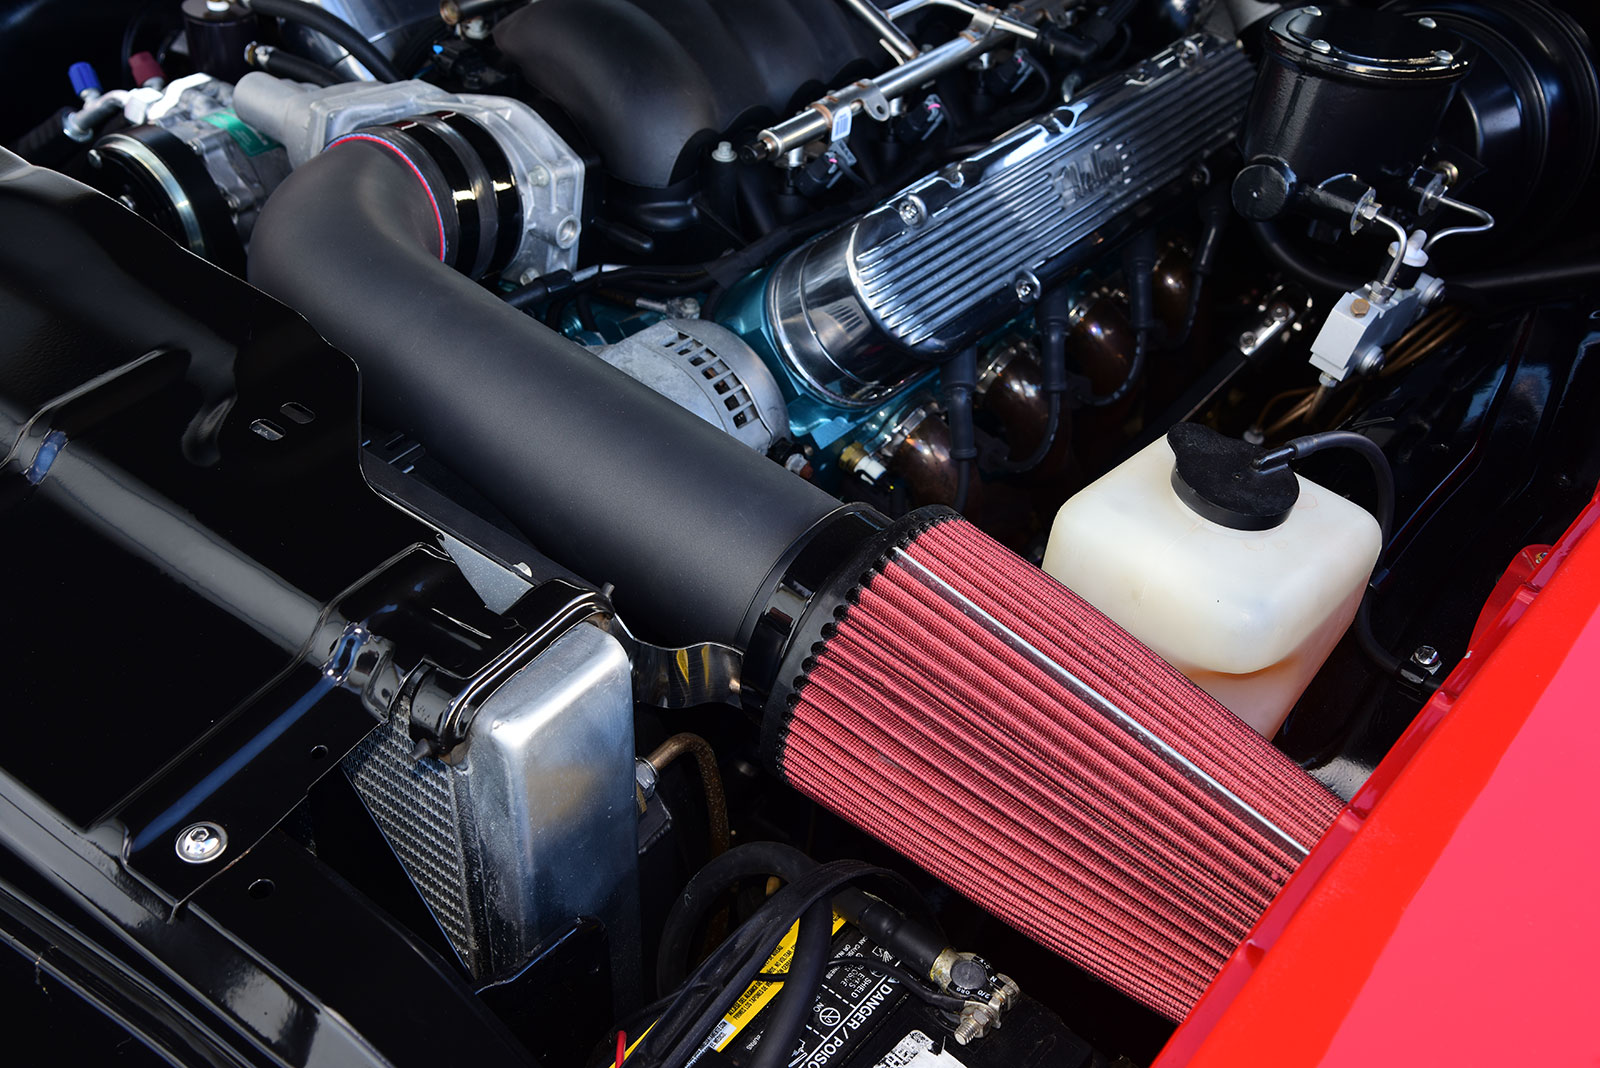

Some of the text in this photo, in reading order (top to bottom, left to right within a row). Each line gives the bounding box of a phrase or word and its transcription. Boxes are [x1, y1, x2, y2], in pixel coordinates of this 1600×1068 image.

[847, 971, 865, 990] EYES
[849, 975, 872, 1000] SHIELD
[977, 989, 992, 999] 2/0
[811, 1000, 825, 1014] NO
[845, 981, 894, 1032] DANGER
